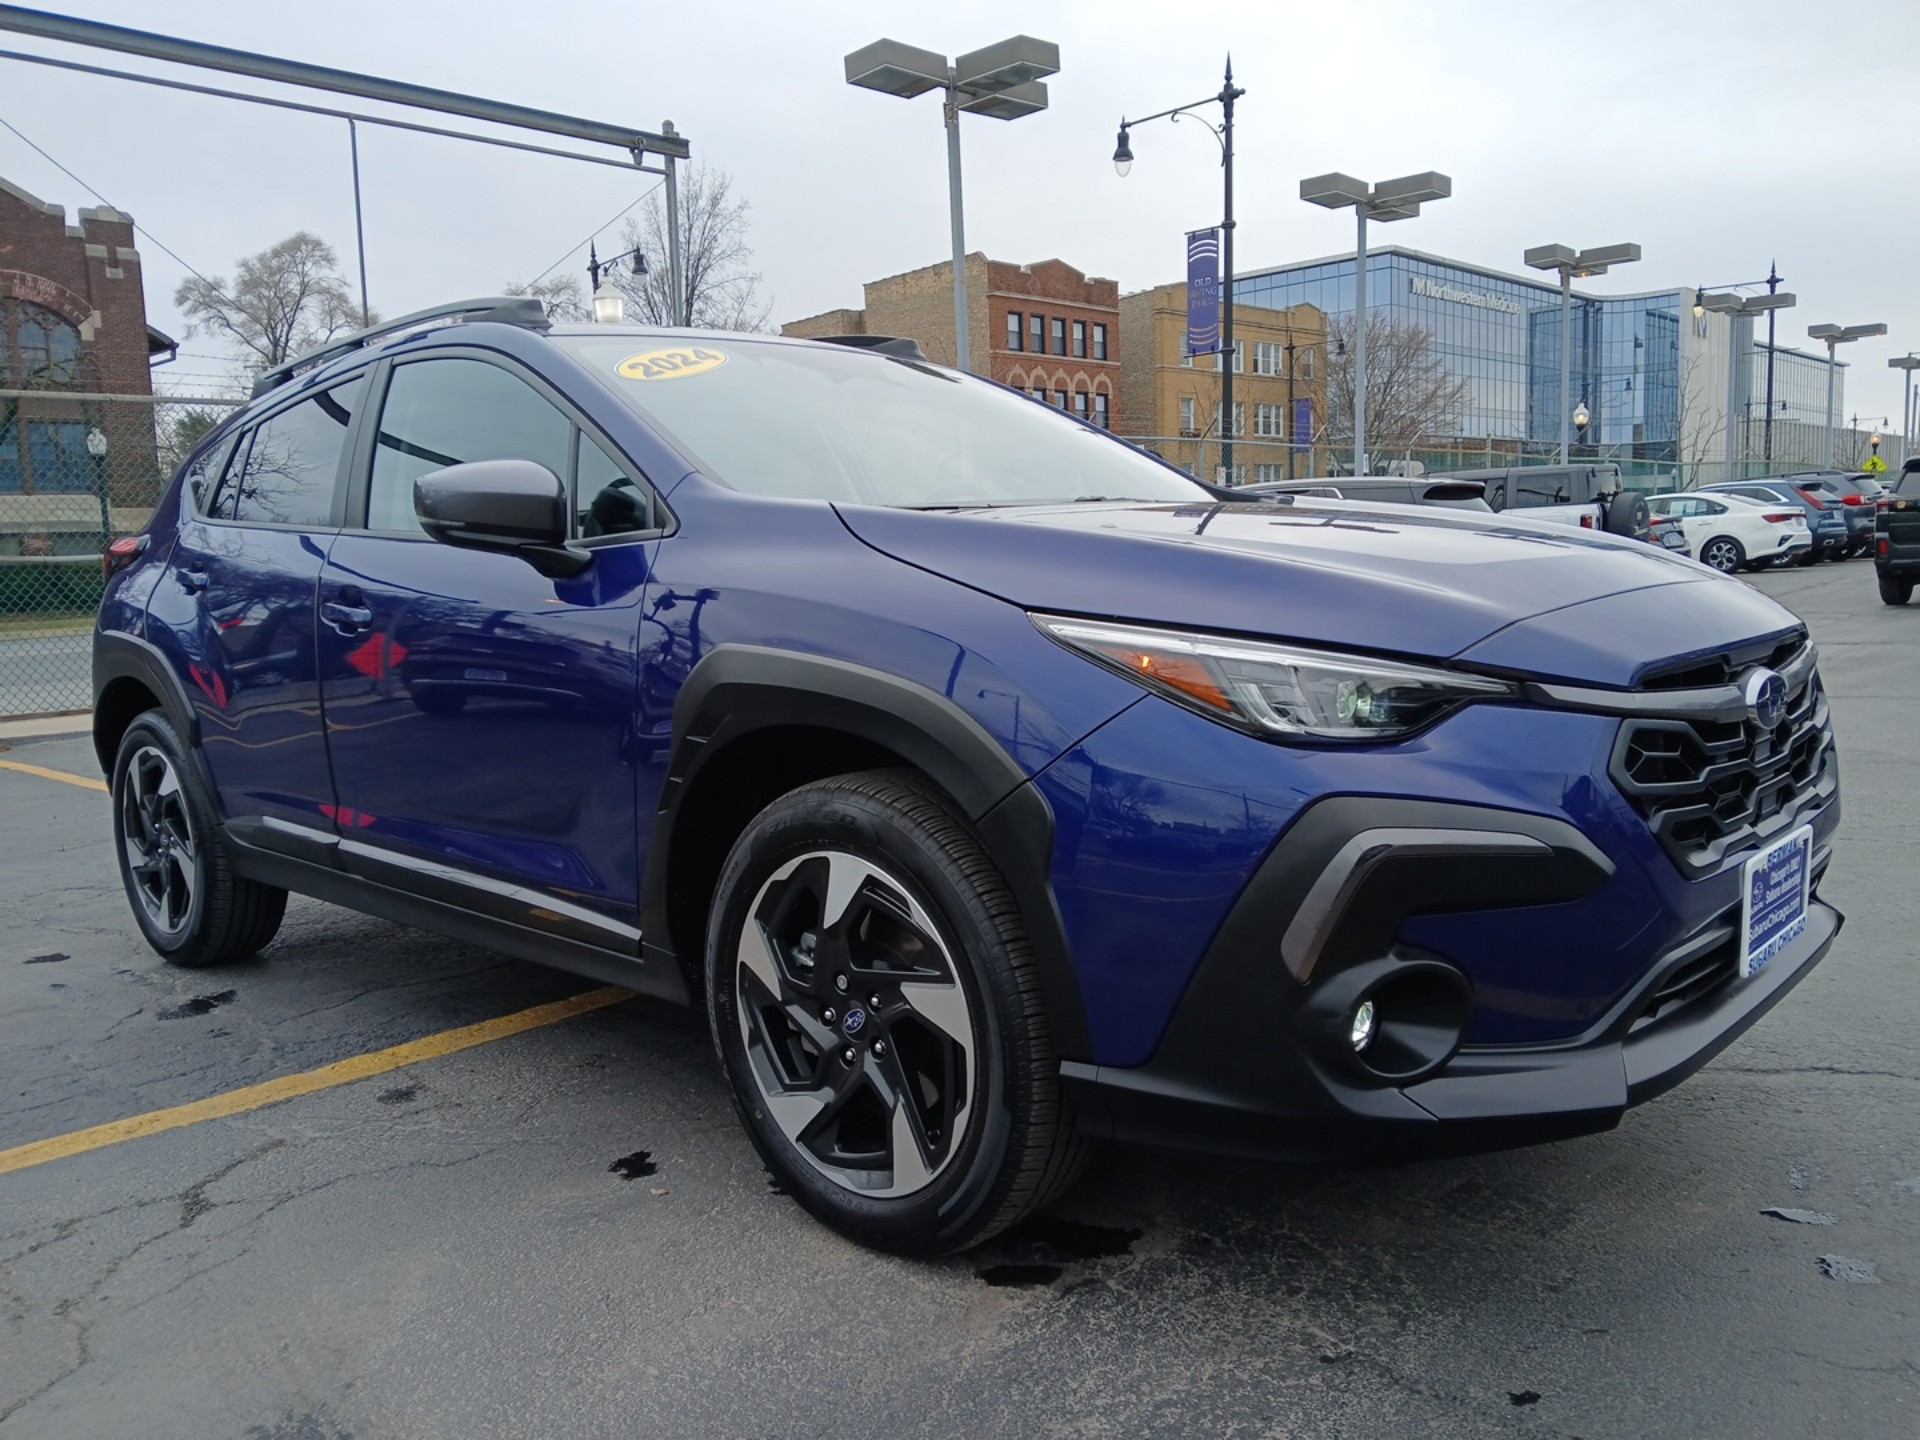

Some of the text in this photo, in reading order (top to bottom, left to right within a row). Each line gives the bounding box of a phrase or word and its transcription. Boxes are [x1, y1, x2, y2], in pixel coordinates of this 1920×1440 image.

[1194, 276, 1211, 288] OLD
[1426, 280, 1486, 308] Northwestern
[1486, 293, 1521, 315] Medicine
[627, 348, 721, 378] 2024
